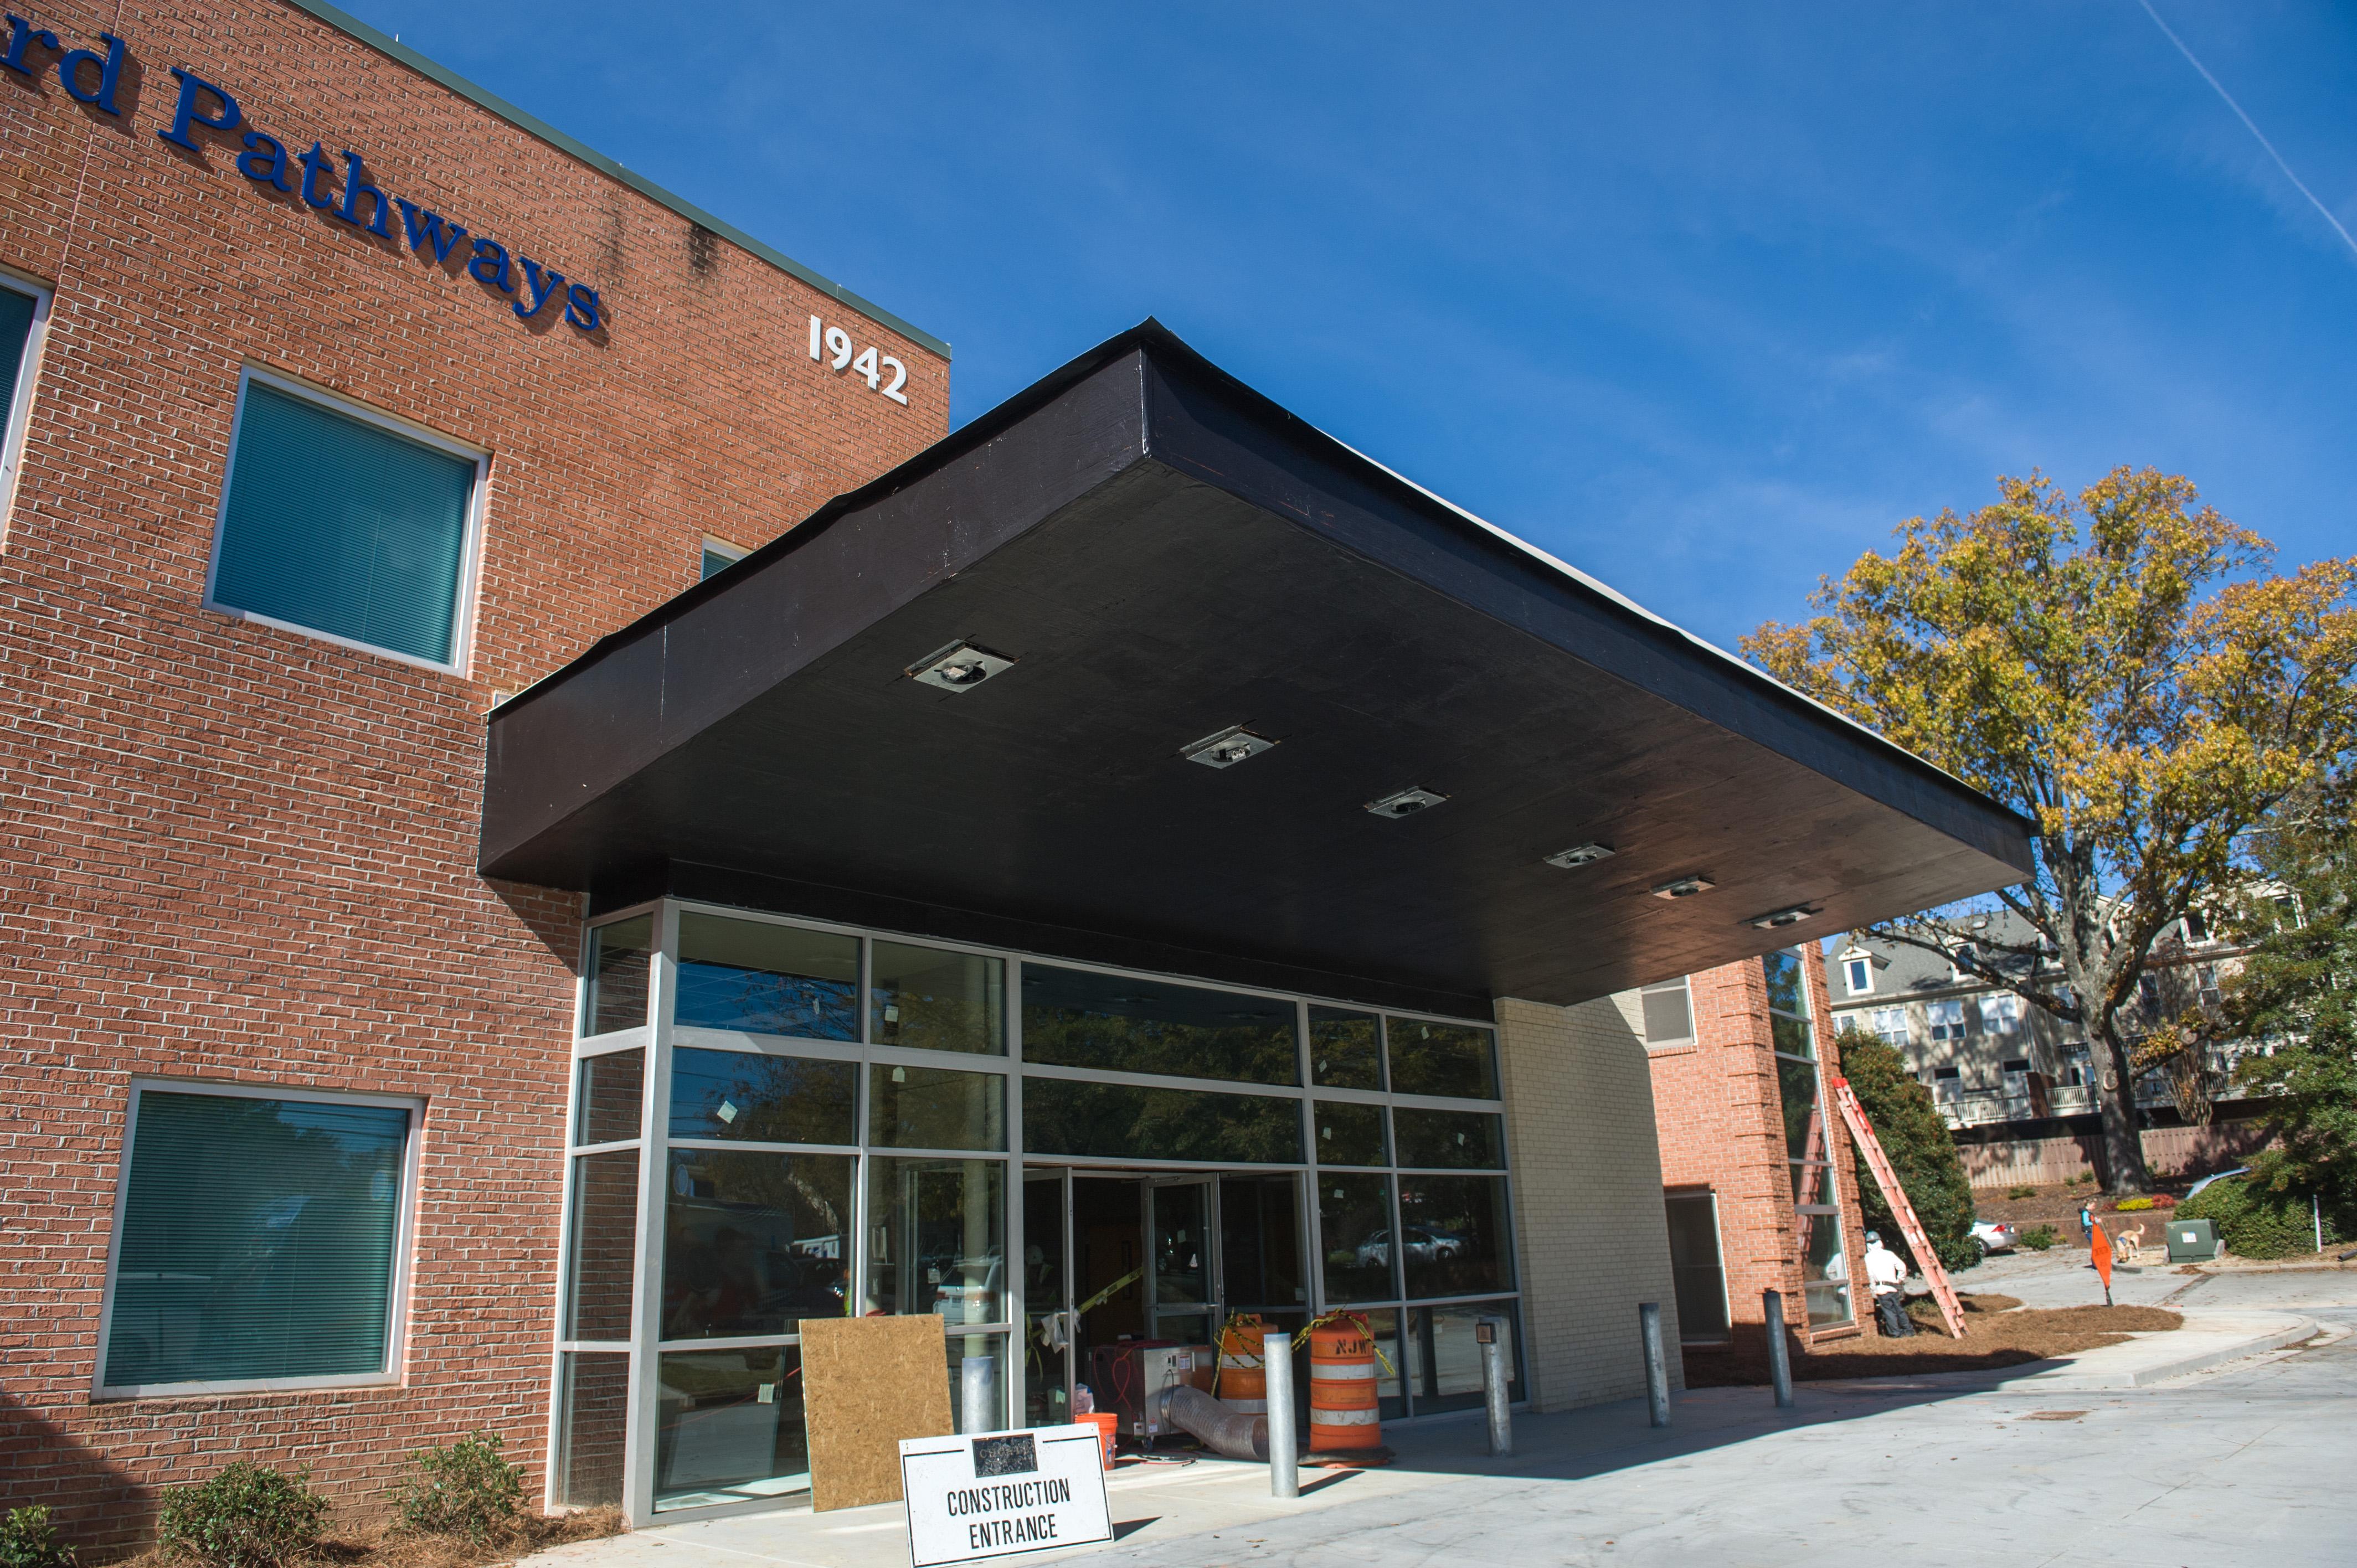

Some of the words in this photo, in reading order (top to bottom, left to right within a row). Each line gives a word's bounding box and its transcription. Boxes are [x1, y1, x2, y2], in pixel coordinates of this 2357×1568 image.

[0, 13, 125, 115] rd
[157, 67, 599, 331] Pathways
[810, 314, 908, 406] 1942
[948, 1478, 1071, 1517] CONSTRUCTION
[969, 1514, 1058, 1549] ENTRANCE
